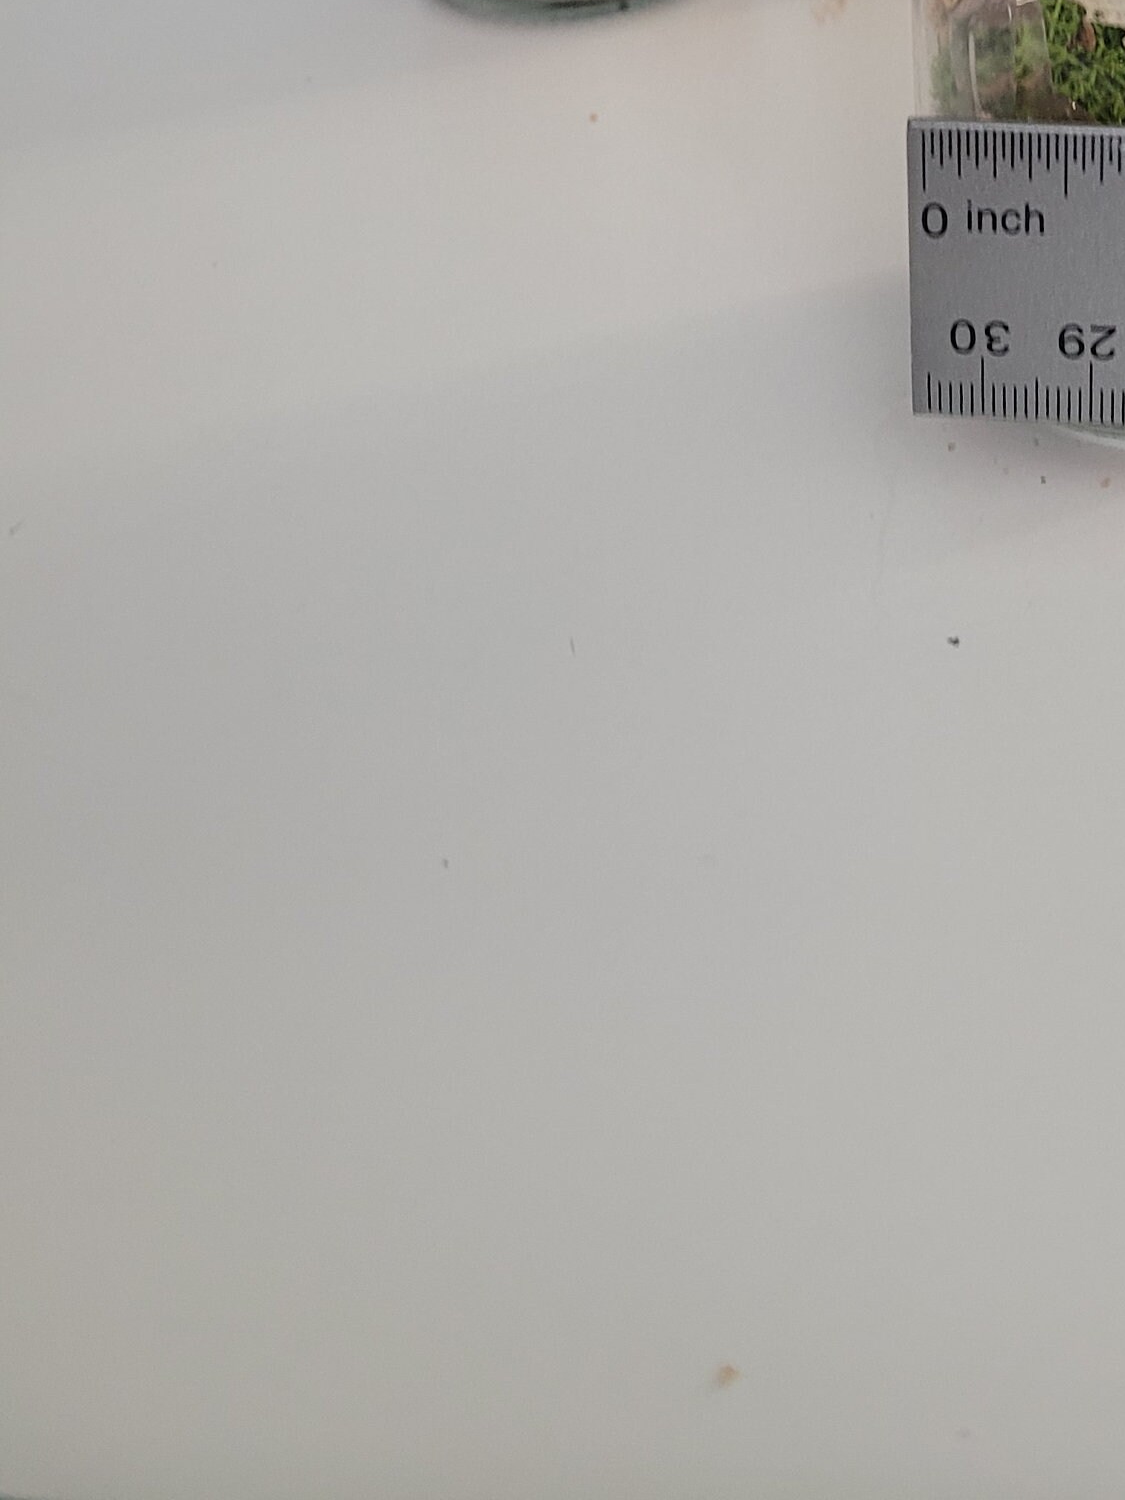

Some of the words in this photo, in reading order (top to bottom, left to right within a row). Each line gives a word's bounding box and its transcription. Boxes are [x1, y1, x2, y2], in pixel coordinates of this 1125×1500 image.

[921, 202, 948, 239] 0
[965, 200, 1046, 236] inch
[949, 319, 1011, 357] 30
[1057, 323, 1118, 361] 29
